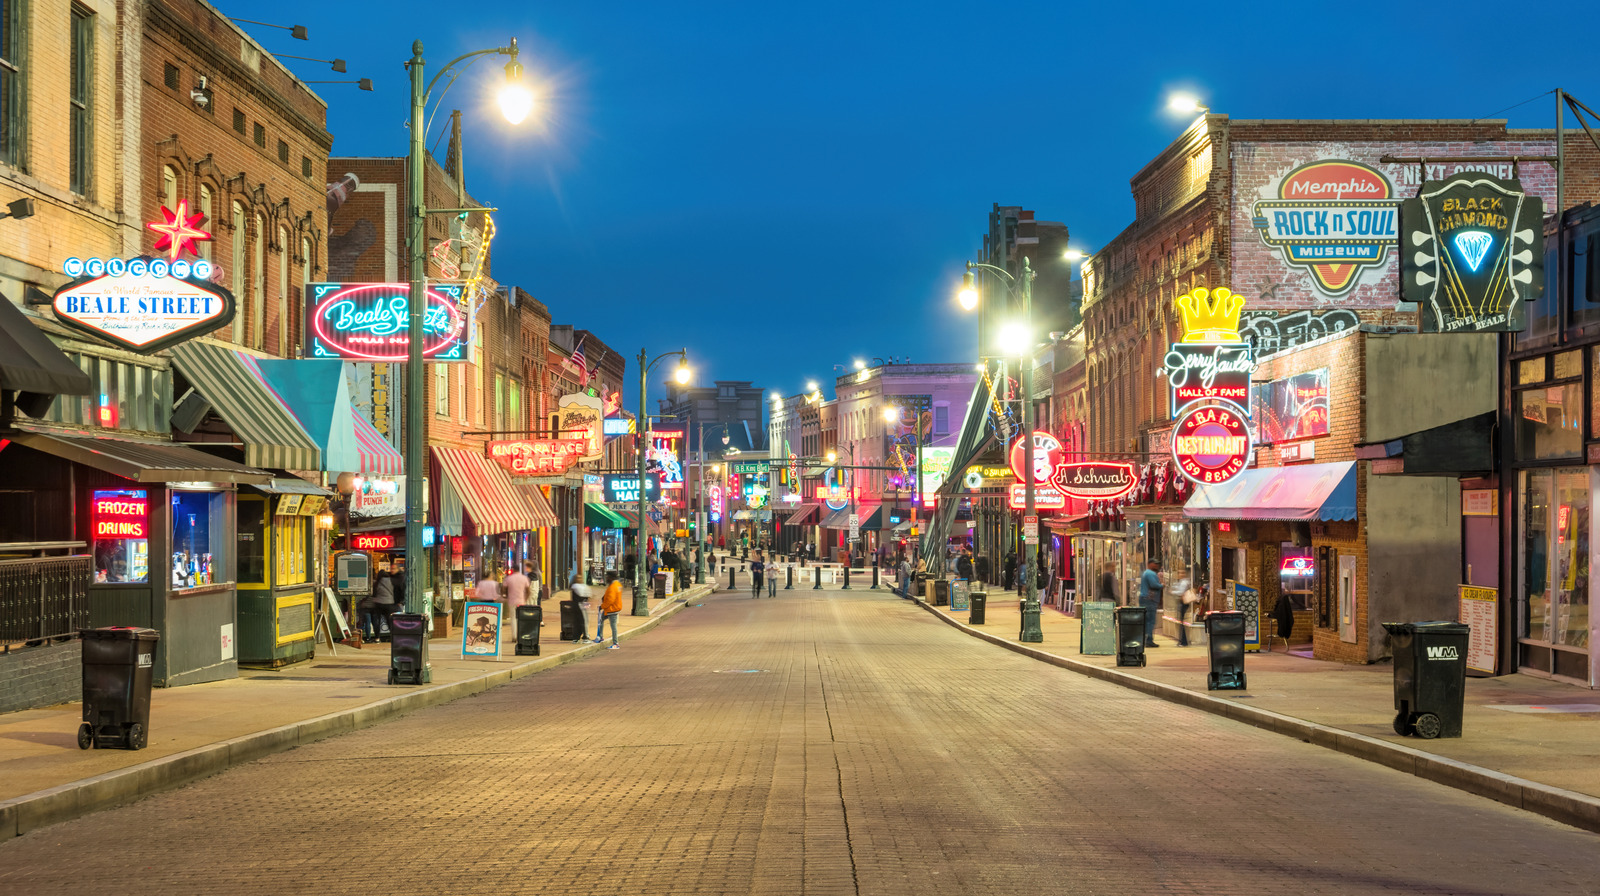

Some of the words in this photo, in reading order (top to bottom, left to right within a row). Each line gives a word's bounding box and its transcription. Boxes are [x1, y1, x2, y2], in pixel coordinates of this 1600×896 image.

[1291, 178, 1380, 200] Memphis
[1442, 197, 1502, 212] BLACK
[1274, 210, 1328, 236] ROCK
[1346, 210, 1396, 236] SOUL
[1439, 211, 1508, 232] DIAMOND
[65, 257, 212, 280] WELCOME
[66, 296, 131, 314] BEALE
[138, 297, 214, 314] STREET
[324, 297, 392, 330] Beale
[1446, 314, 1477, 331] JEWEL
[1475, 314, 1507, 331] BEALE
[1179, 388, 1203, 397] HALL
[1205, 388, 1217, 397] OF
[1220, 388, 1246, 397] FAME
[1196, 409, 1229, 426] BAR
[1177, 435, 1247, 456] RESTAURANT
[512, 457, 564, 471] CAFE
[1181, 458, 1201, 476] 159
[1205, 457, 1244, 482] BEALE
[1073, 466, 1132, 484] Schwab
[611, 480, 653, 490] BLUS
[97, 500, 145, 515] FROZEN
[363, 497, 383, 506] PUNCH
[98, 522, 143, 536] DRINKS
[359, 537, 389, 549] PATIO
[468, 605, 483, 613] FRESH
[484, 606, 498, 614] FUDGE
[1427, 646, 1459, 657] WM
